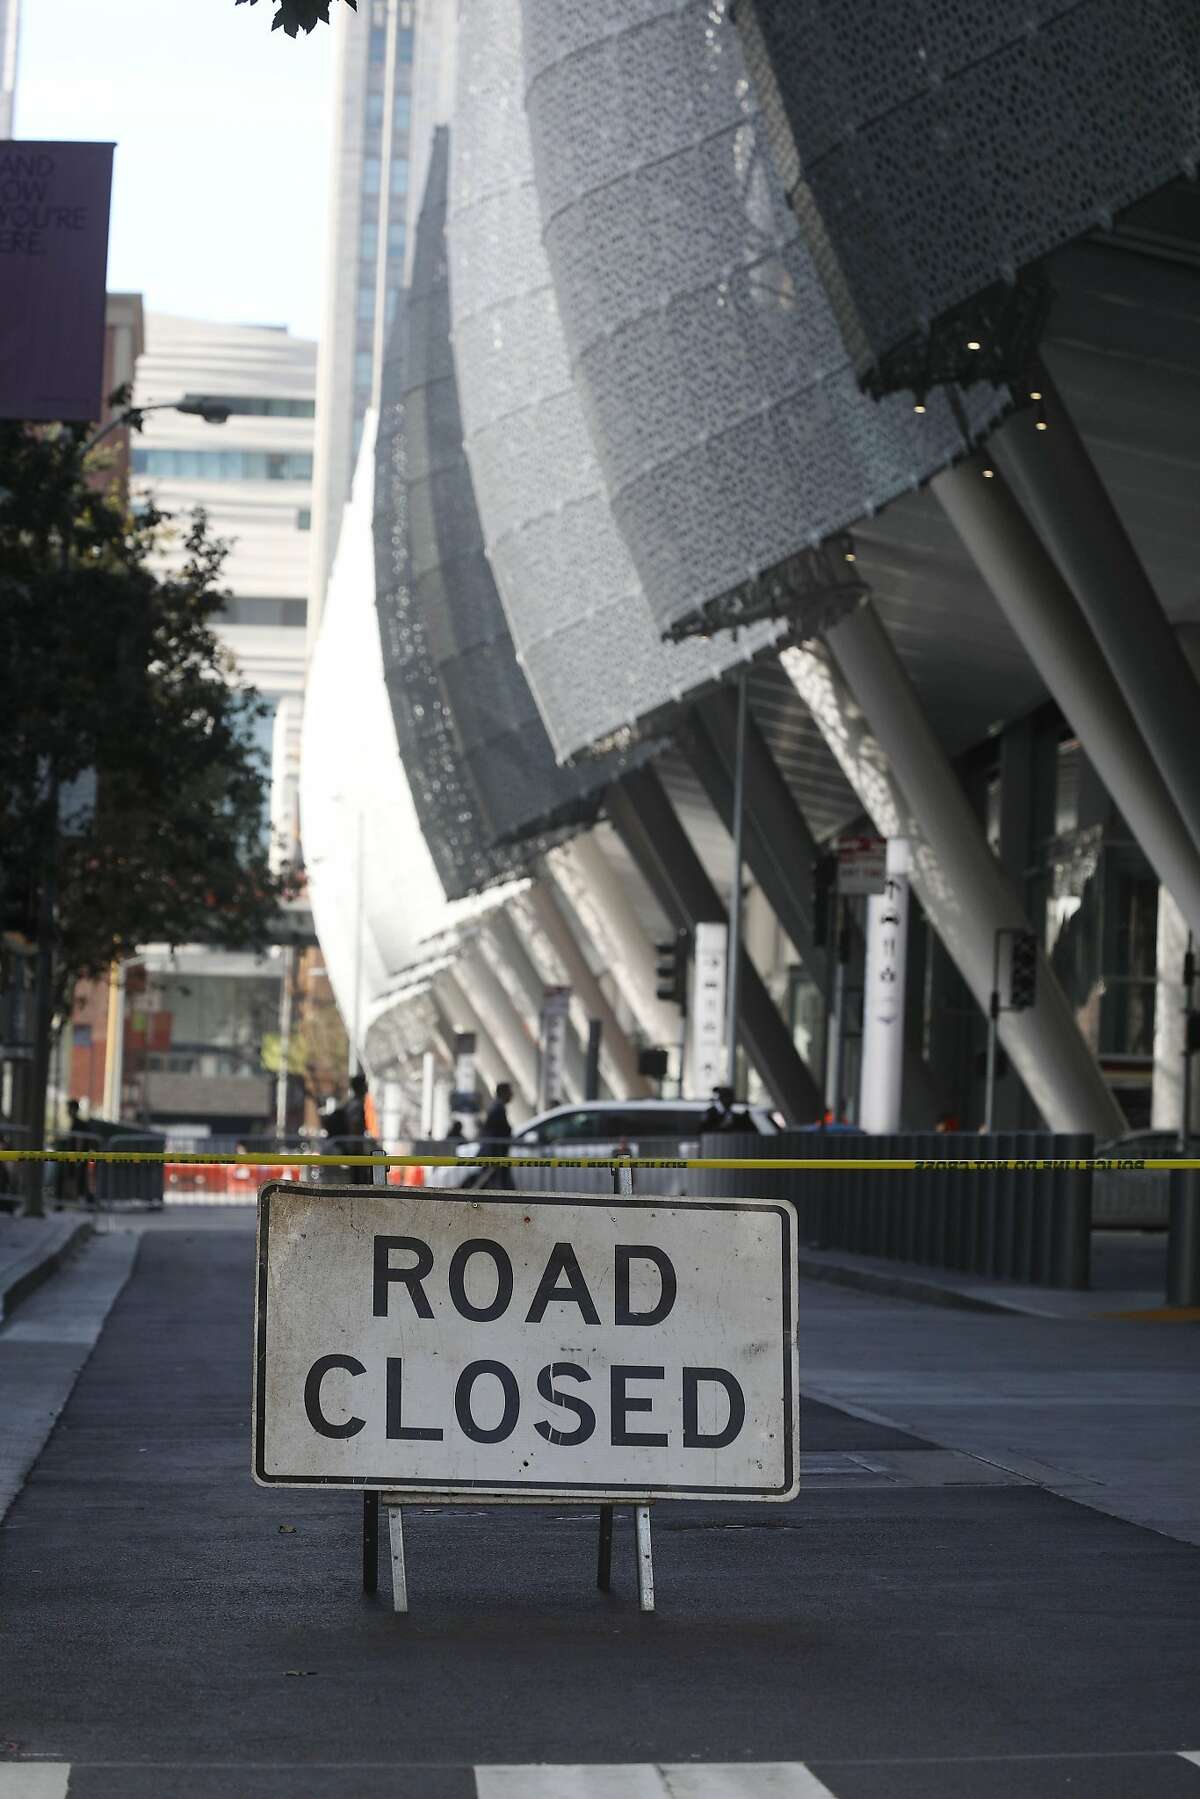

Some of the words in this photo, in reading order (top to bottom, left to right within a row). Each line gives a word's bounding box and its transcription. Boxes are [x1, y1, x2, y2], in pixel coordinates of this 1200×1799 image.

[0, 153, 55, 176] AND
[372, 1235, 678, 1326] ROAD
[304, 1354, 746, 1448] CLOSED
